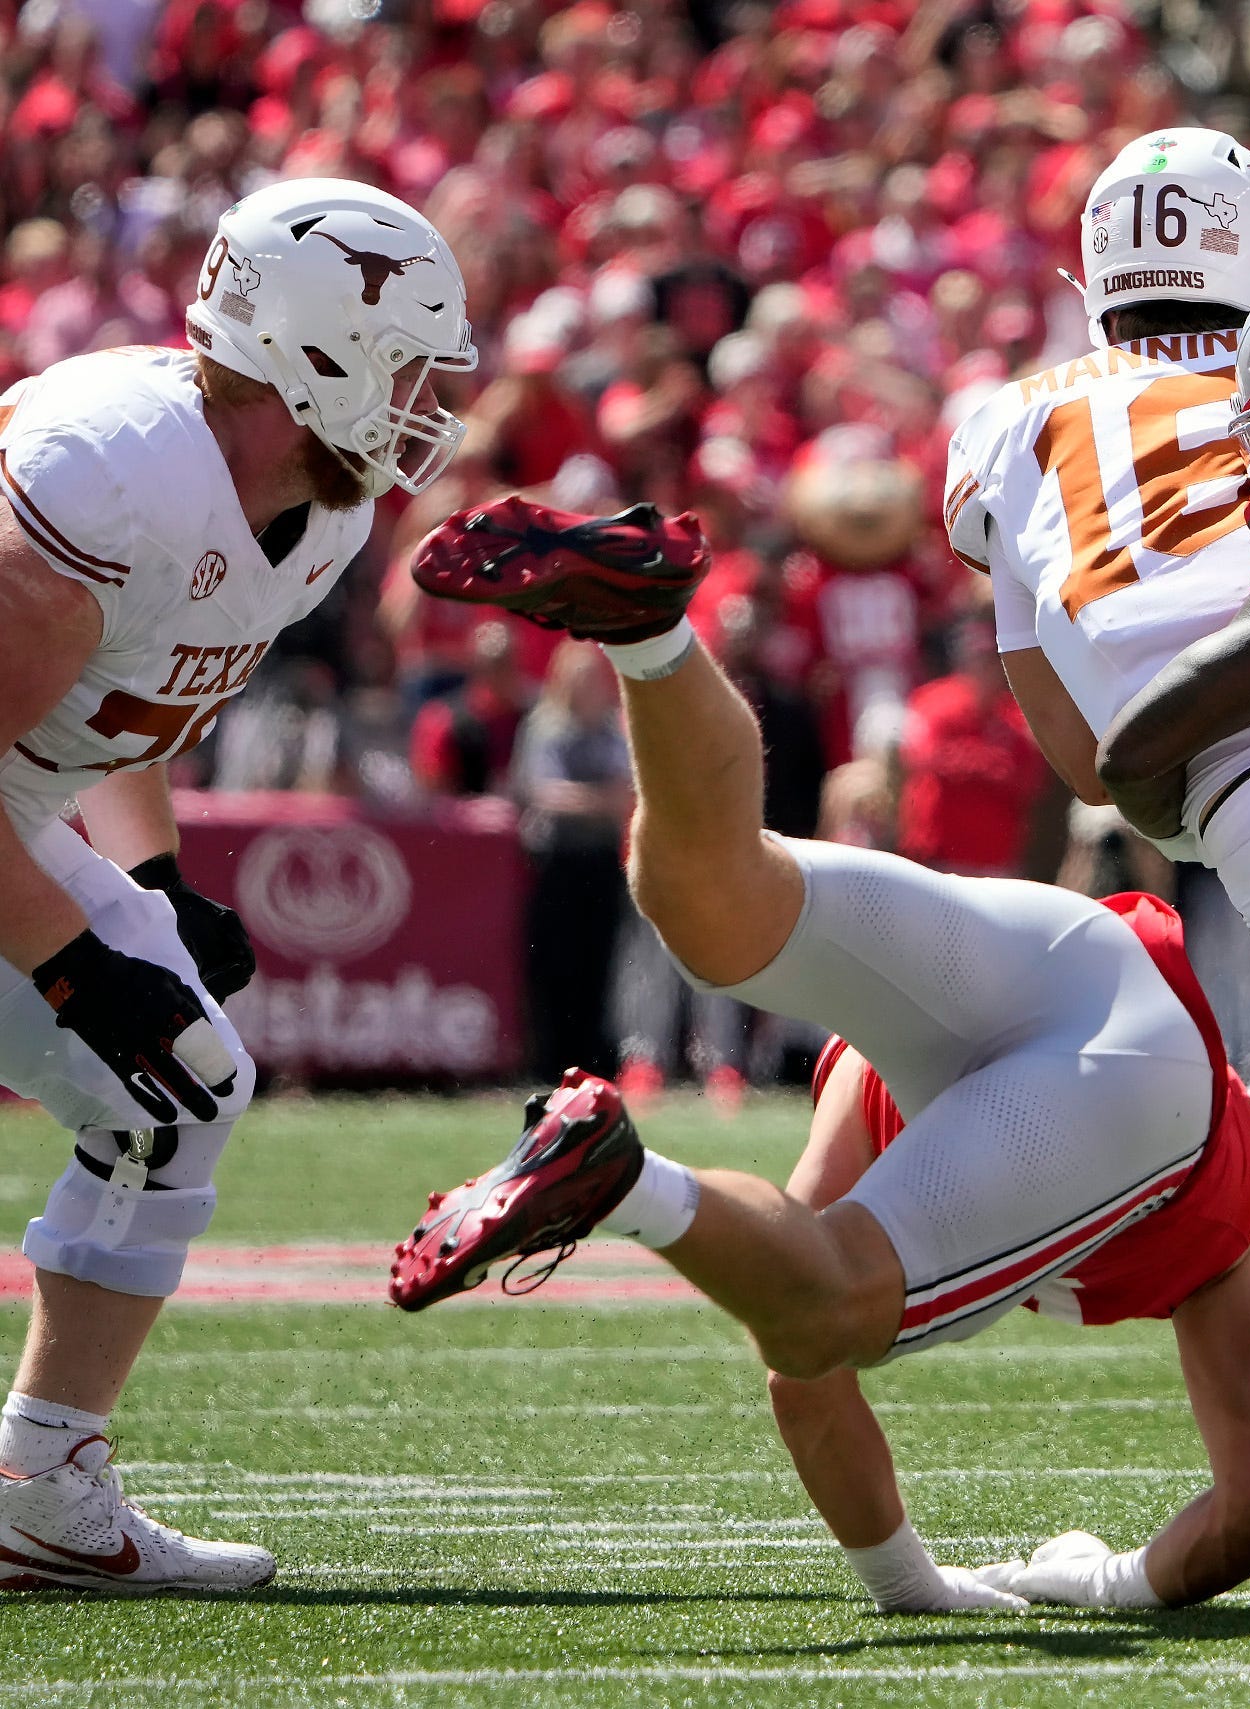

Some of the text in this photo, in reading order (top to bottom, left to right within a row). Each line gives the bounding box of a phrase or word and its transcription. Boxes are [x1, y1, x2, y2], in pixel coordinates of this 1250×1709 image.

[1133, 183, 1188, 249] 16
[1103, 269, 1205, 296] LONGHORNS
[191, 550, 227, 600] SEC
